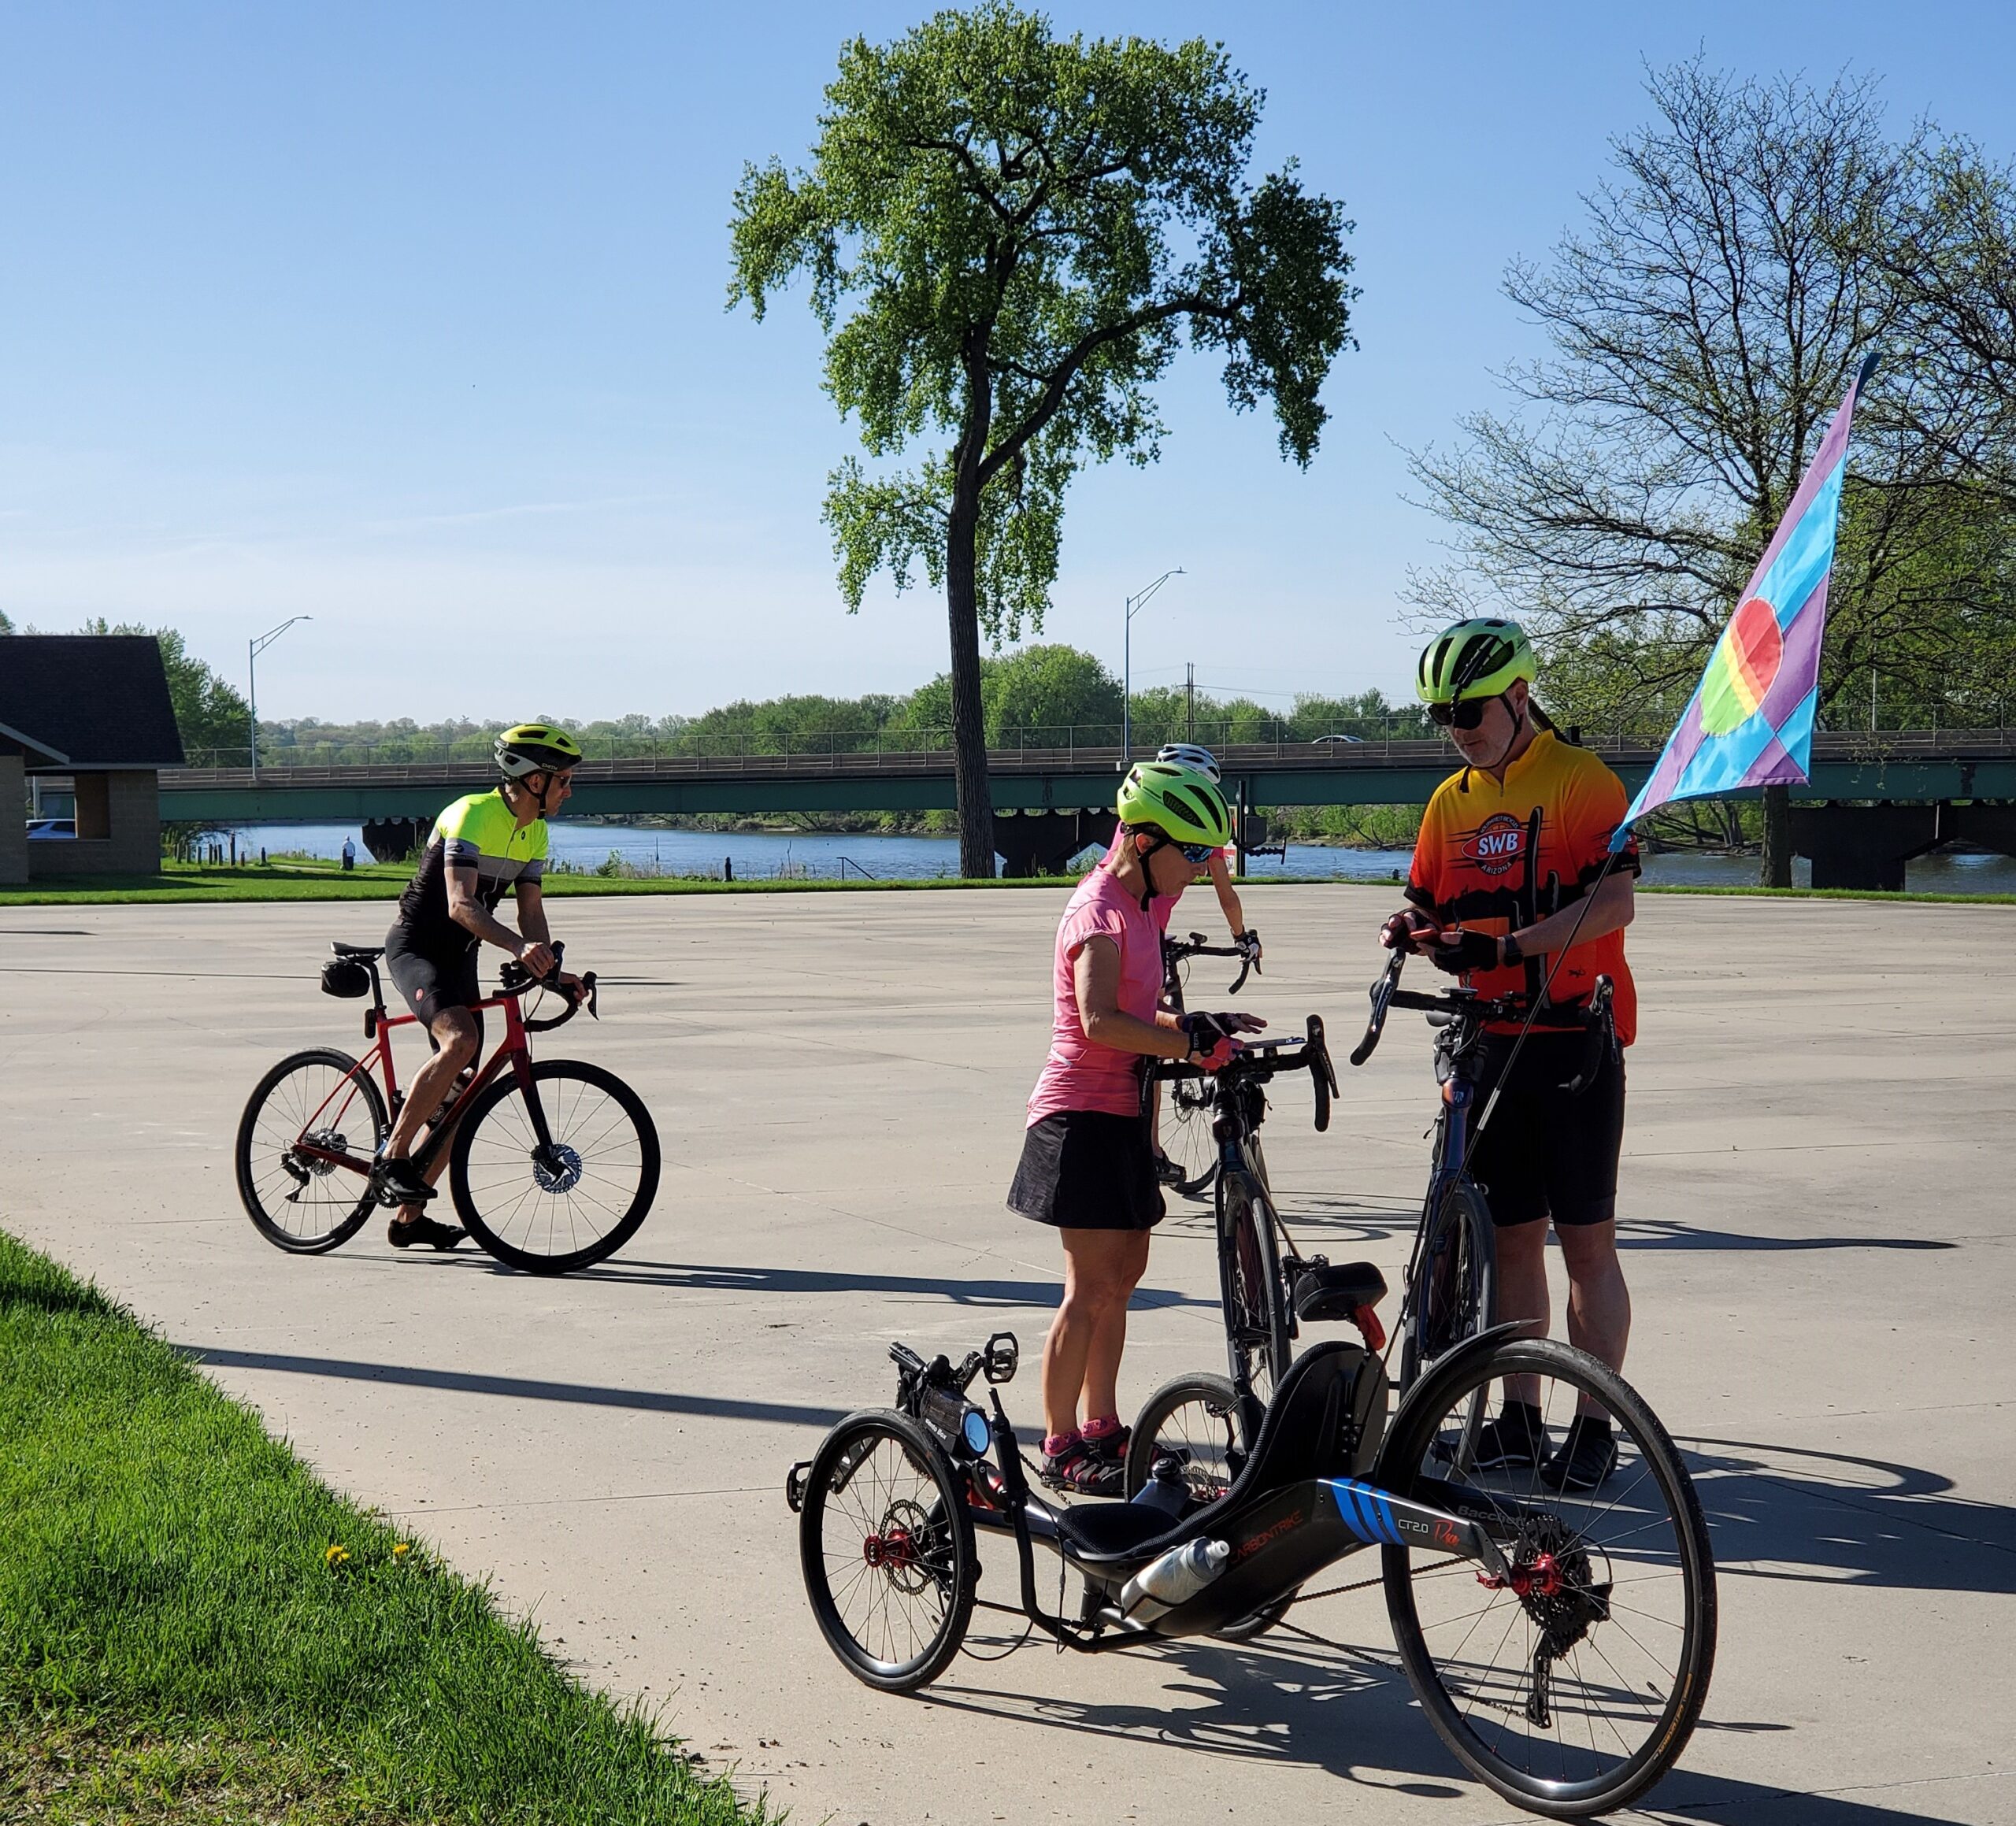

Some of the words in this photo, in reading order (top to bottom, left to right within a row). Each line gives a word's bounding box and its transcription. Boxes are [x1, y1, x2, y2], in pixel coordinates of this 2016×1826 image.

[1478, 833, 1518, 856] SWB
[1481, 862, 1512, 875] ARIZONA
[936, 1428, 947, 1440] Box
